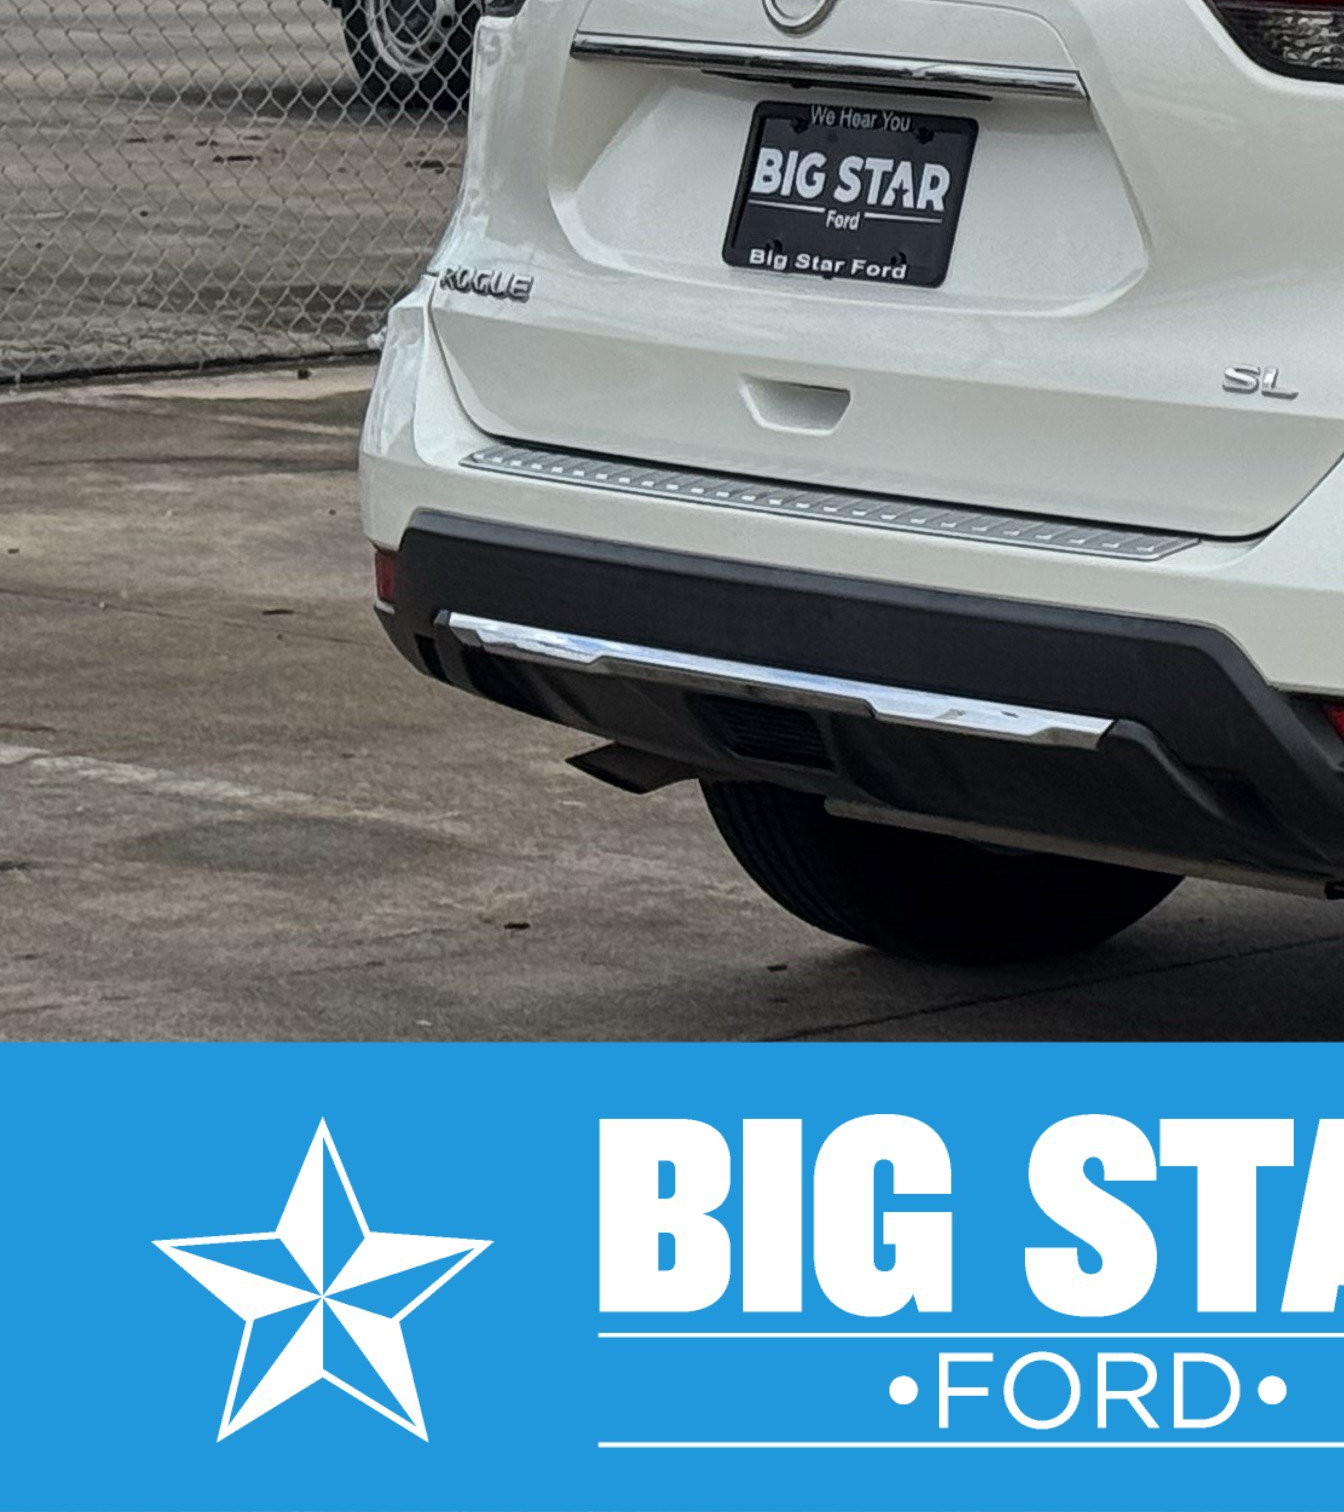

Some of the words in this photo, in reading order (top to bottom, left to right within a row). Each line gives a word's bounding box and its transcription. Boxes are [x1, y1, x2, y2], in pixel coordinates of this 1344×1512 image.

[810, 105, 835, 126] We
[840, 110, 877, 129] Hear
[881, 111, 911, 132] You
[751, 147, 827, 199] BIG
[833, 155, 950, 211] STAR
[825, 209, 861, 231] Ford
[749, 248, 788, 271] Big
[794, 252, 845, 274] Star
[850, 258, 907, 280] Ford
[440, 265, 534, 304] ROGUE
[1222, 363, 1299, 401] SL
